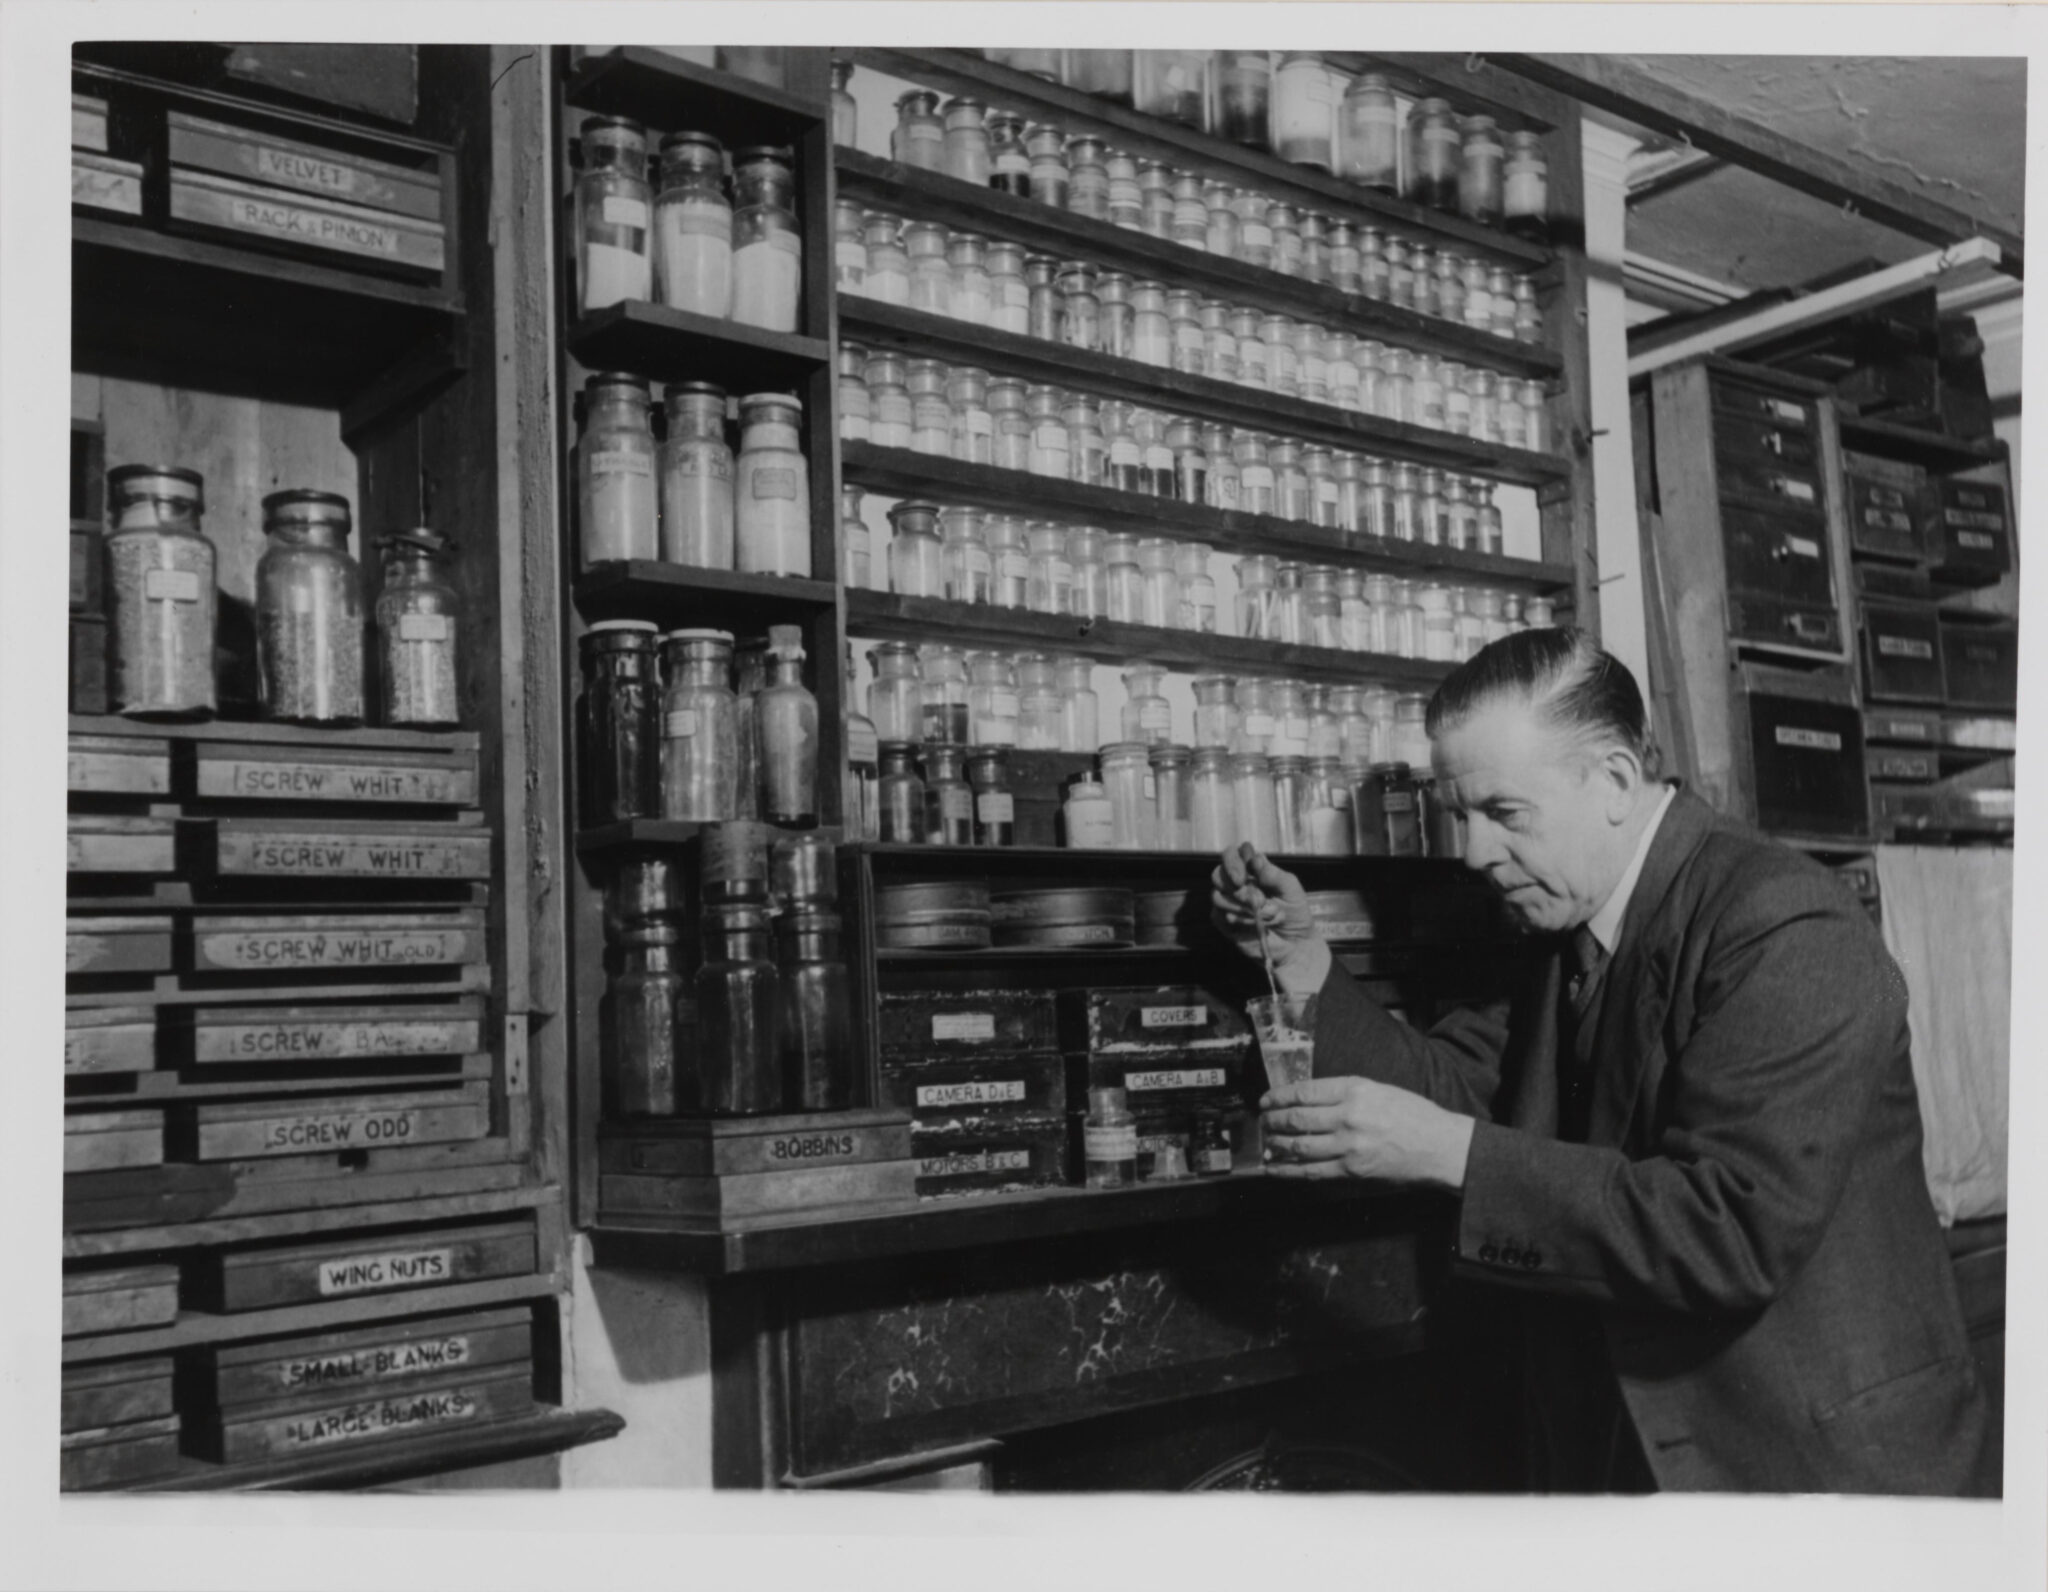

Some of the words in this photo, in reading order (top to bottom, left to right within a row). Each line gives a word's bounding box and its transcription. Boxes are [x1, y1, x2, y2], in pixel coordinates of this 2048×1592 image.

[270, 153, 342, 186] VELVET
[245, 204, 300, 232] RACK
[321, 219, 384, 248] PINION
[245, 771, 325, 792] SCREW
[350, 775, 403, 796] WHIT
[264, 847, 345, 868] SCREW
[368, 850, 424, 870] WHIT
[245, 938, 326, 961] SCREW
[338, 940, 393, 960] WHIT
[241, 1031, 324, 1052] SCREW
[1133, 1071, 1183, 1089] CAMERA
[924, 1085, 983, 1104] CAMERA
[273, 1121, 352, 1147] SCREW
[364, 1117, 411, 1140] ODD
[775, 1135, 853, 1159] BOBBINS
[920, 1155, 979, 1174] MOTORS
[1010, 1152, 1022, 1168] C
[327, 1262, 384, 1288] WING
[390, 1254, 443, 1280] NUTS
[288, 1361, 364, 1386] SMALL
[375, 1340, 465, 1373] BLANKS
[297, 1407, 370, 1442] LARGE
[381, 1394, 467, 1428] BLANKS
